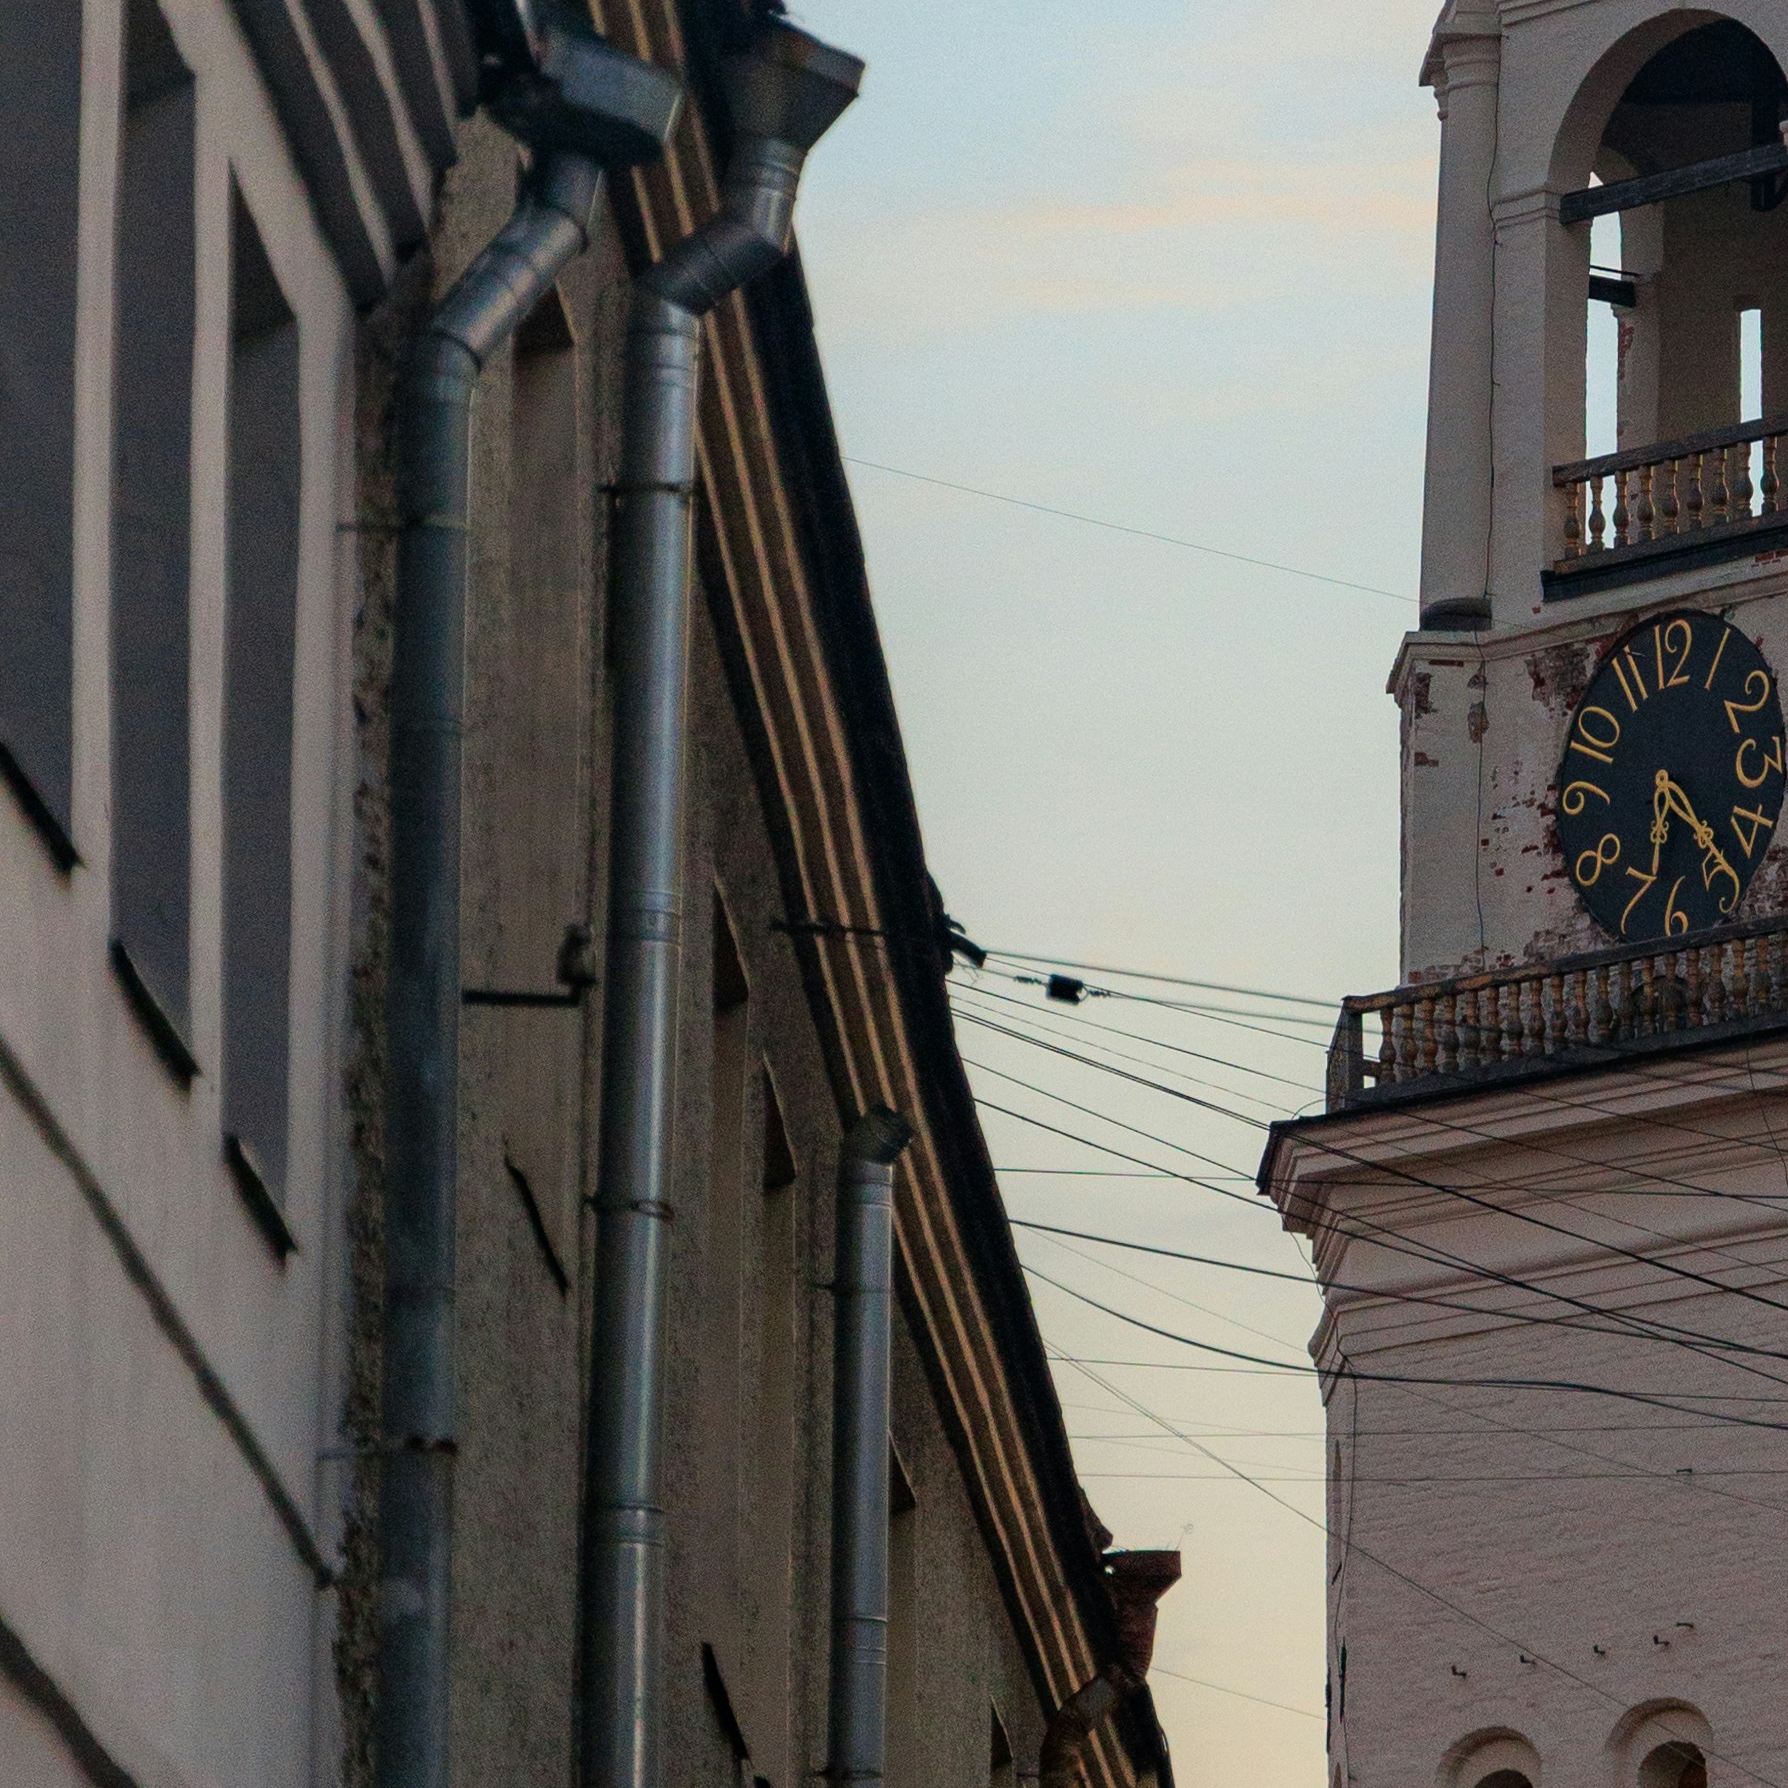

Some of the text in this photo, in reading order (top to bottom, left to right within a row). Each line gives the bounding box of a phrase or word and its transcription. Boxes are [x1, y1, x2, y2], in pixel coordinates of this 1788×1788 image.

[1611, 644, 1649, 712] 11
[1654, 618, 1692, 690] 12
[1704, 627, 1731, 690] 1
[1723, 669, 1770, 734] 2
[1569, 705, 1621, 764] 10
[1735, 735, 1782, 789] 3
[1562, 780, 1611, 815] 9
[1575, 833, 1621, 886] 8
[1730, 804, 1773, 859] 4
[1620, 866, 1657, 934] 7
[1664, 875, 1689, 937] 6
[1702, 849, 1740, 914] 5
